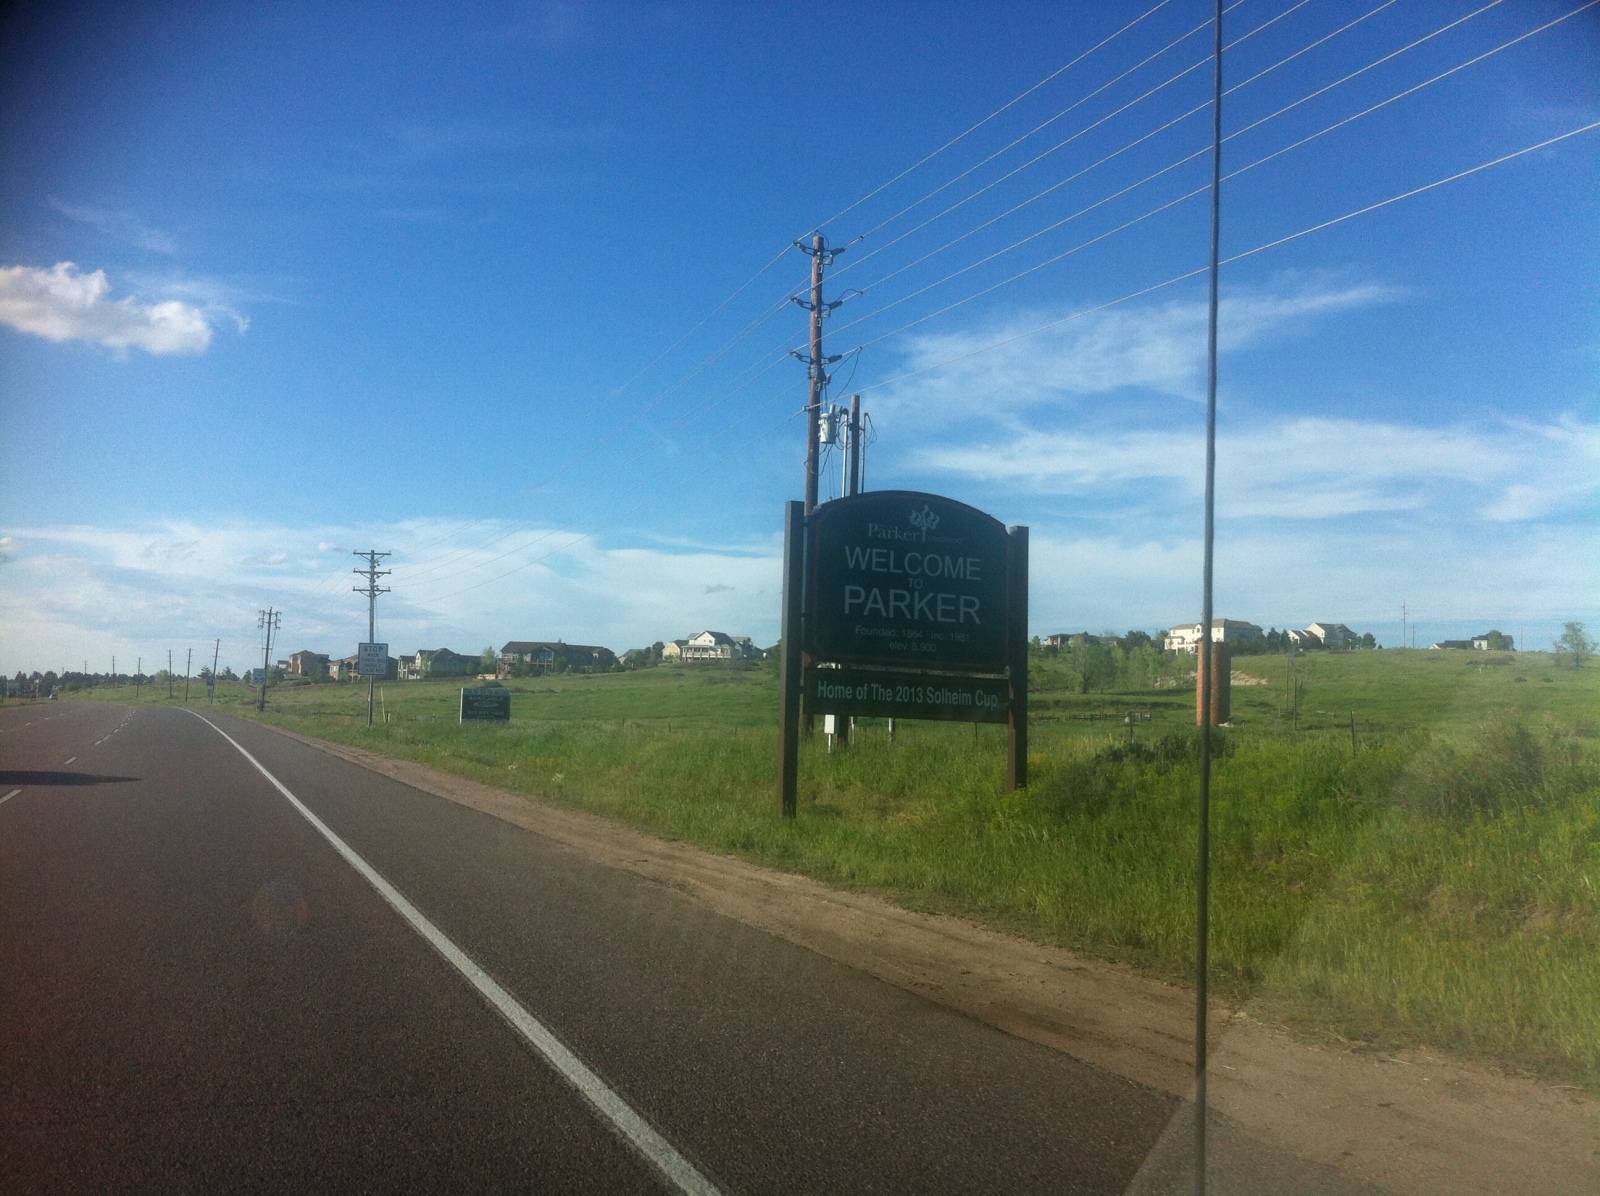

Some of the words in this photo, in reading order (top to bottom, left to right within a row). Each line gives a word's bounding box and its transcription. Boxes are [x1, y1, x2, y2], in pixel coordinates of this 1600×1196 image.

[867, 523, 920, 542] Parker
[845, 545, 981, 581] WELCOME
[908, 578, 923, 589] TO
[844, 585, 981, 625] PARKER
[817, 680, 852, 700] Home
[856, 683, 868, 700] of
[871, 683, 893, 701] The
[895, 686, 923, 703] 2013
[927, 686, 972, 706] Solheim
[975, 689, 998, 711] Cup
